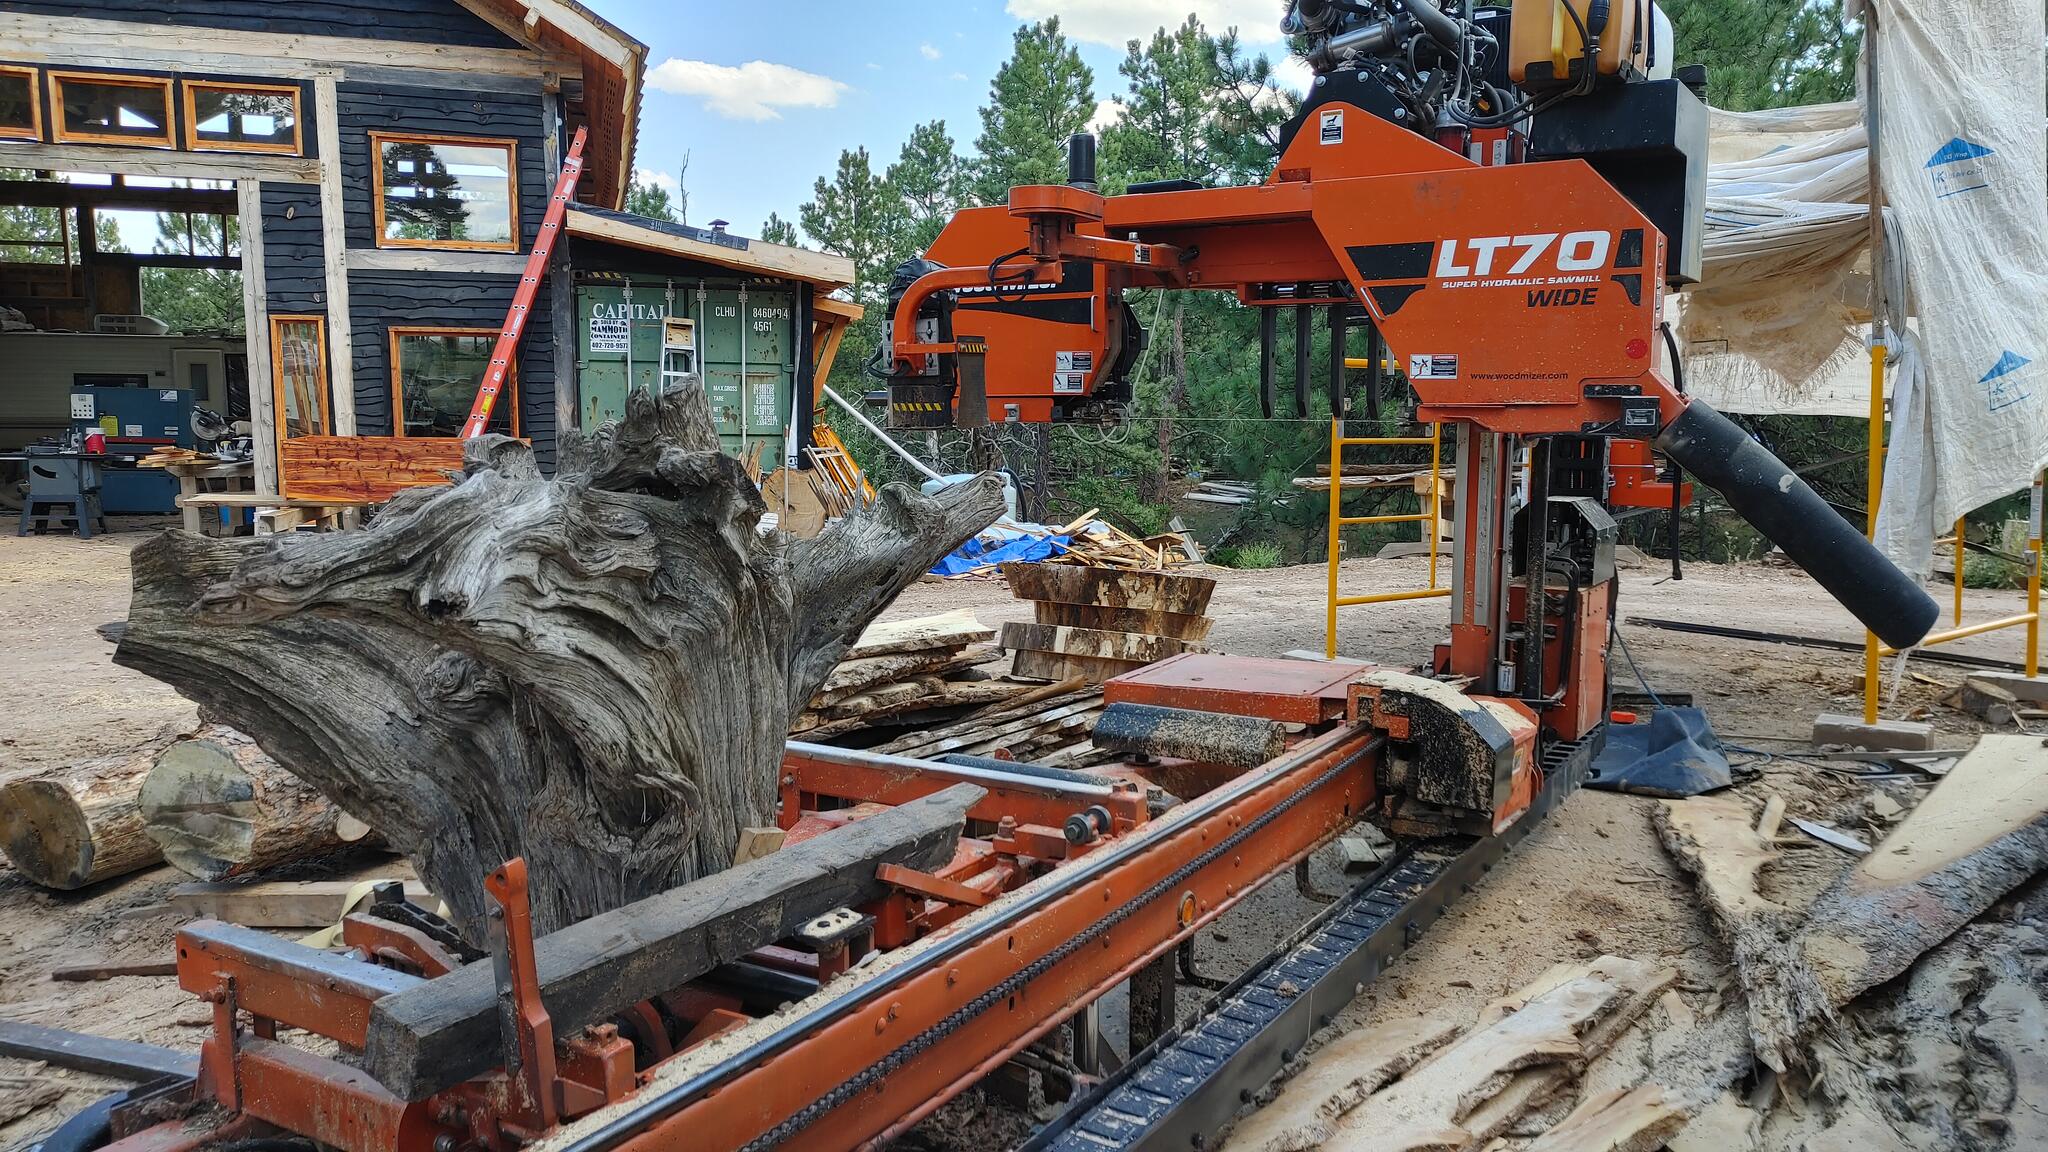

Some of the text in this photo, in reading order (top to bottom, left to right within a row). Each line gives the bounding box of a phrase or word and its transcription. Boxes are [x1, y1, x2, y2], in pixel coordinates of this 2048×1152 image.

[1435, 230, 1611, 278] LT70
[1441, 274, 1601, 289] SUPER HYDRAULIC SAWMILL
[1527, 287, 1599, 308] WIDE
[715, 306, 736, 317] CLHU
[753, 321, 772, 332] 45G1
